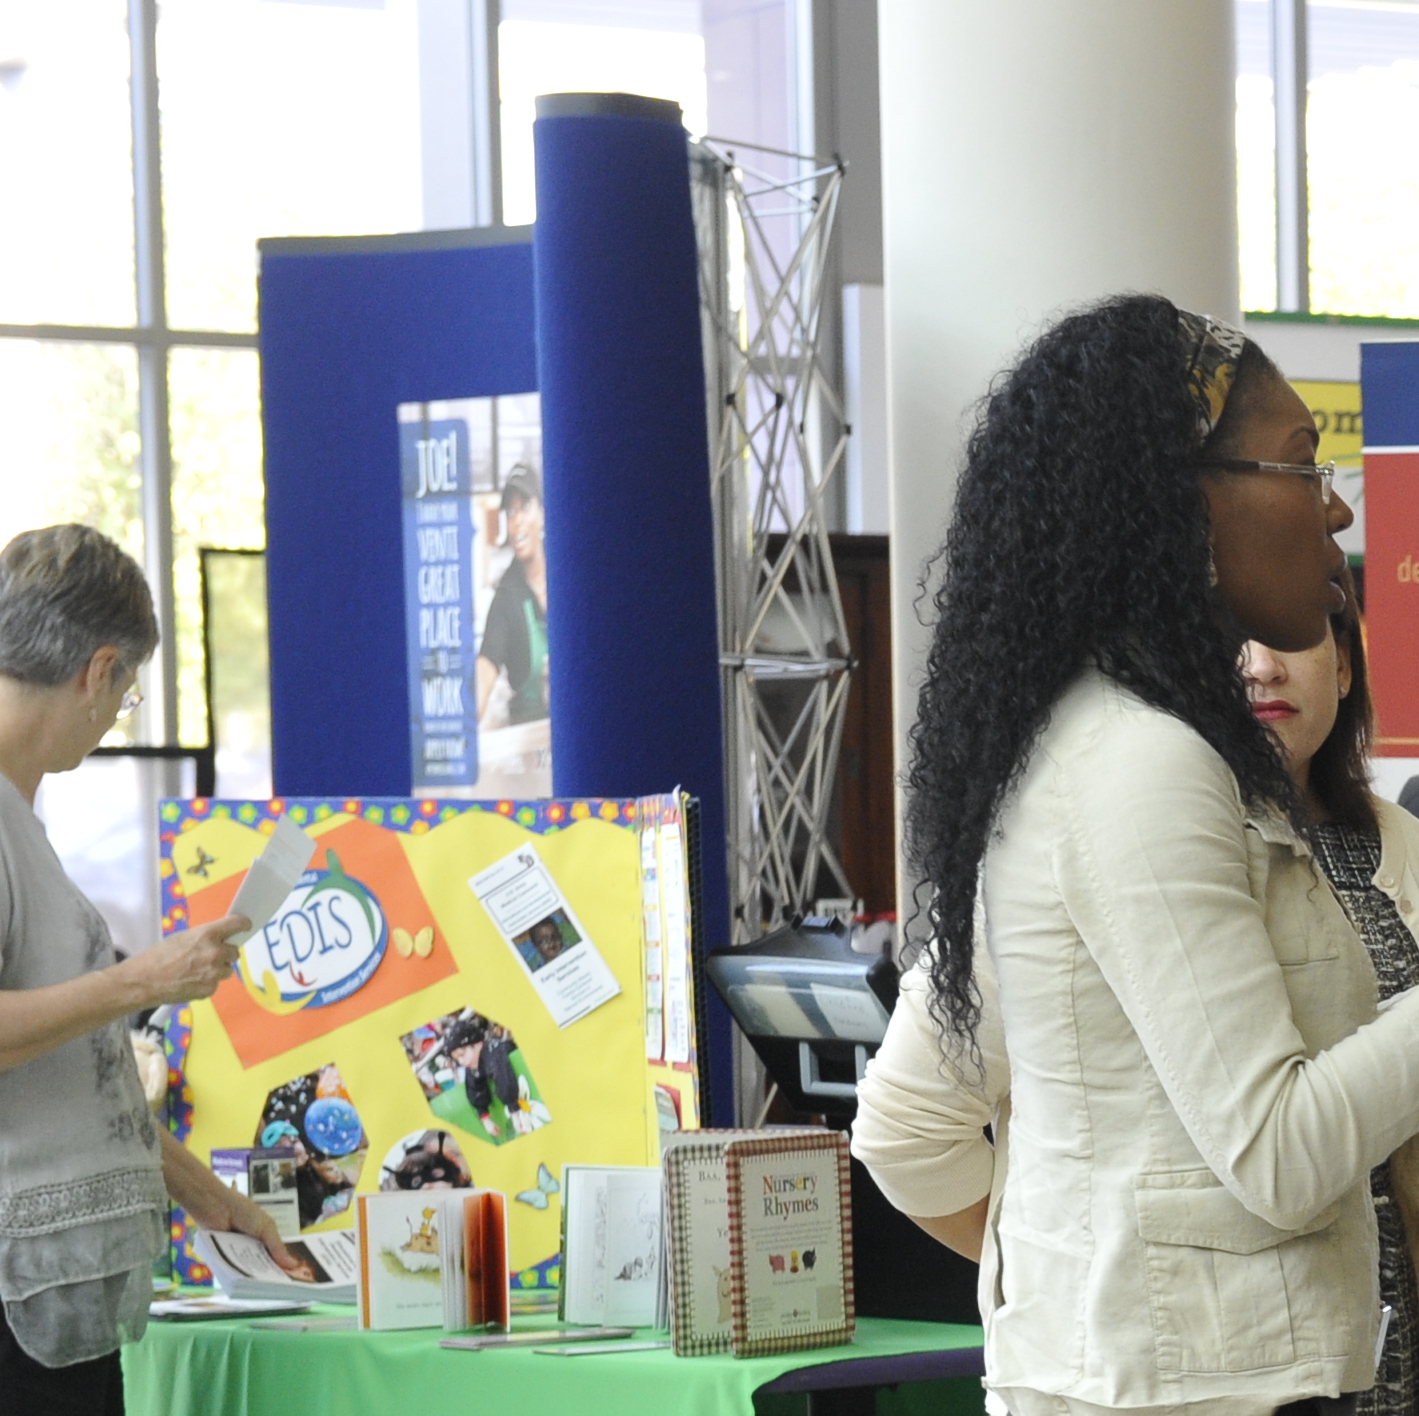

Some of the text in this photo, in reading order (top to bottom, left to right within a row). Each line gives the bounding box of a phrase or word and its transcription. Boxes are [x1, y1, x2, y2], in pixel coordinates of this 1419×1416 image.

[263, 896, 352, 971] EDIS
[762, 1175, 818, 1195] Nursery
[764, 1197, 819, 1220] Rhymes
